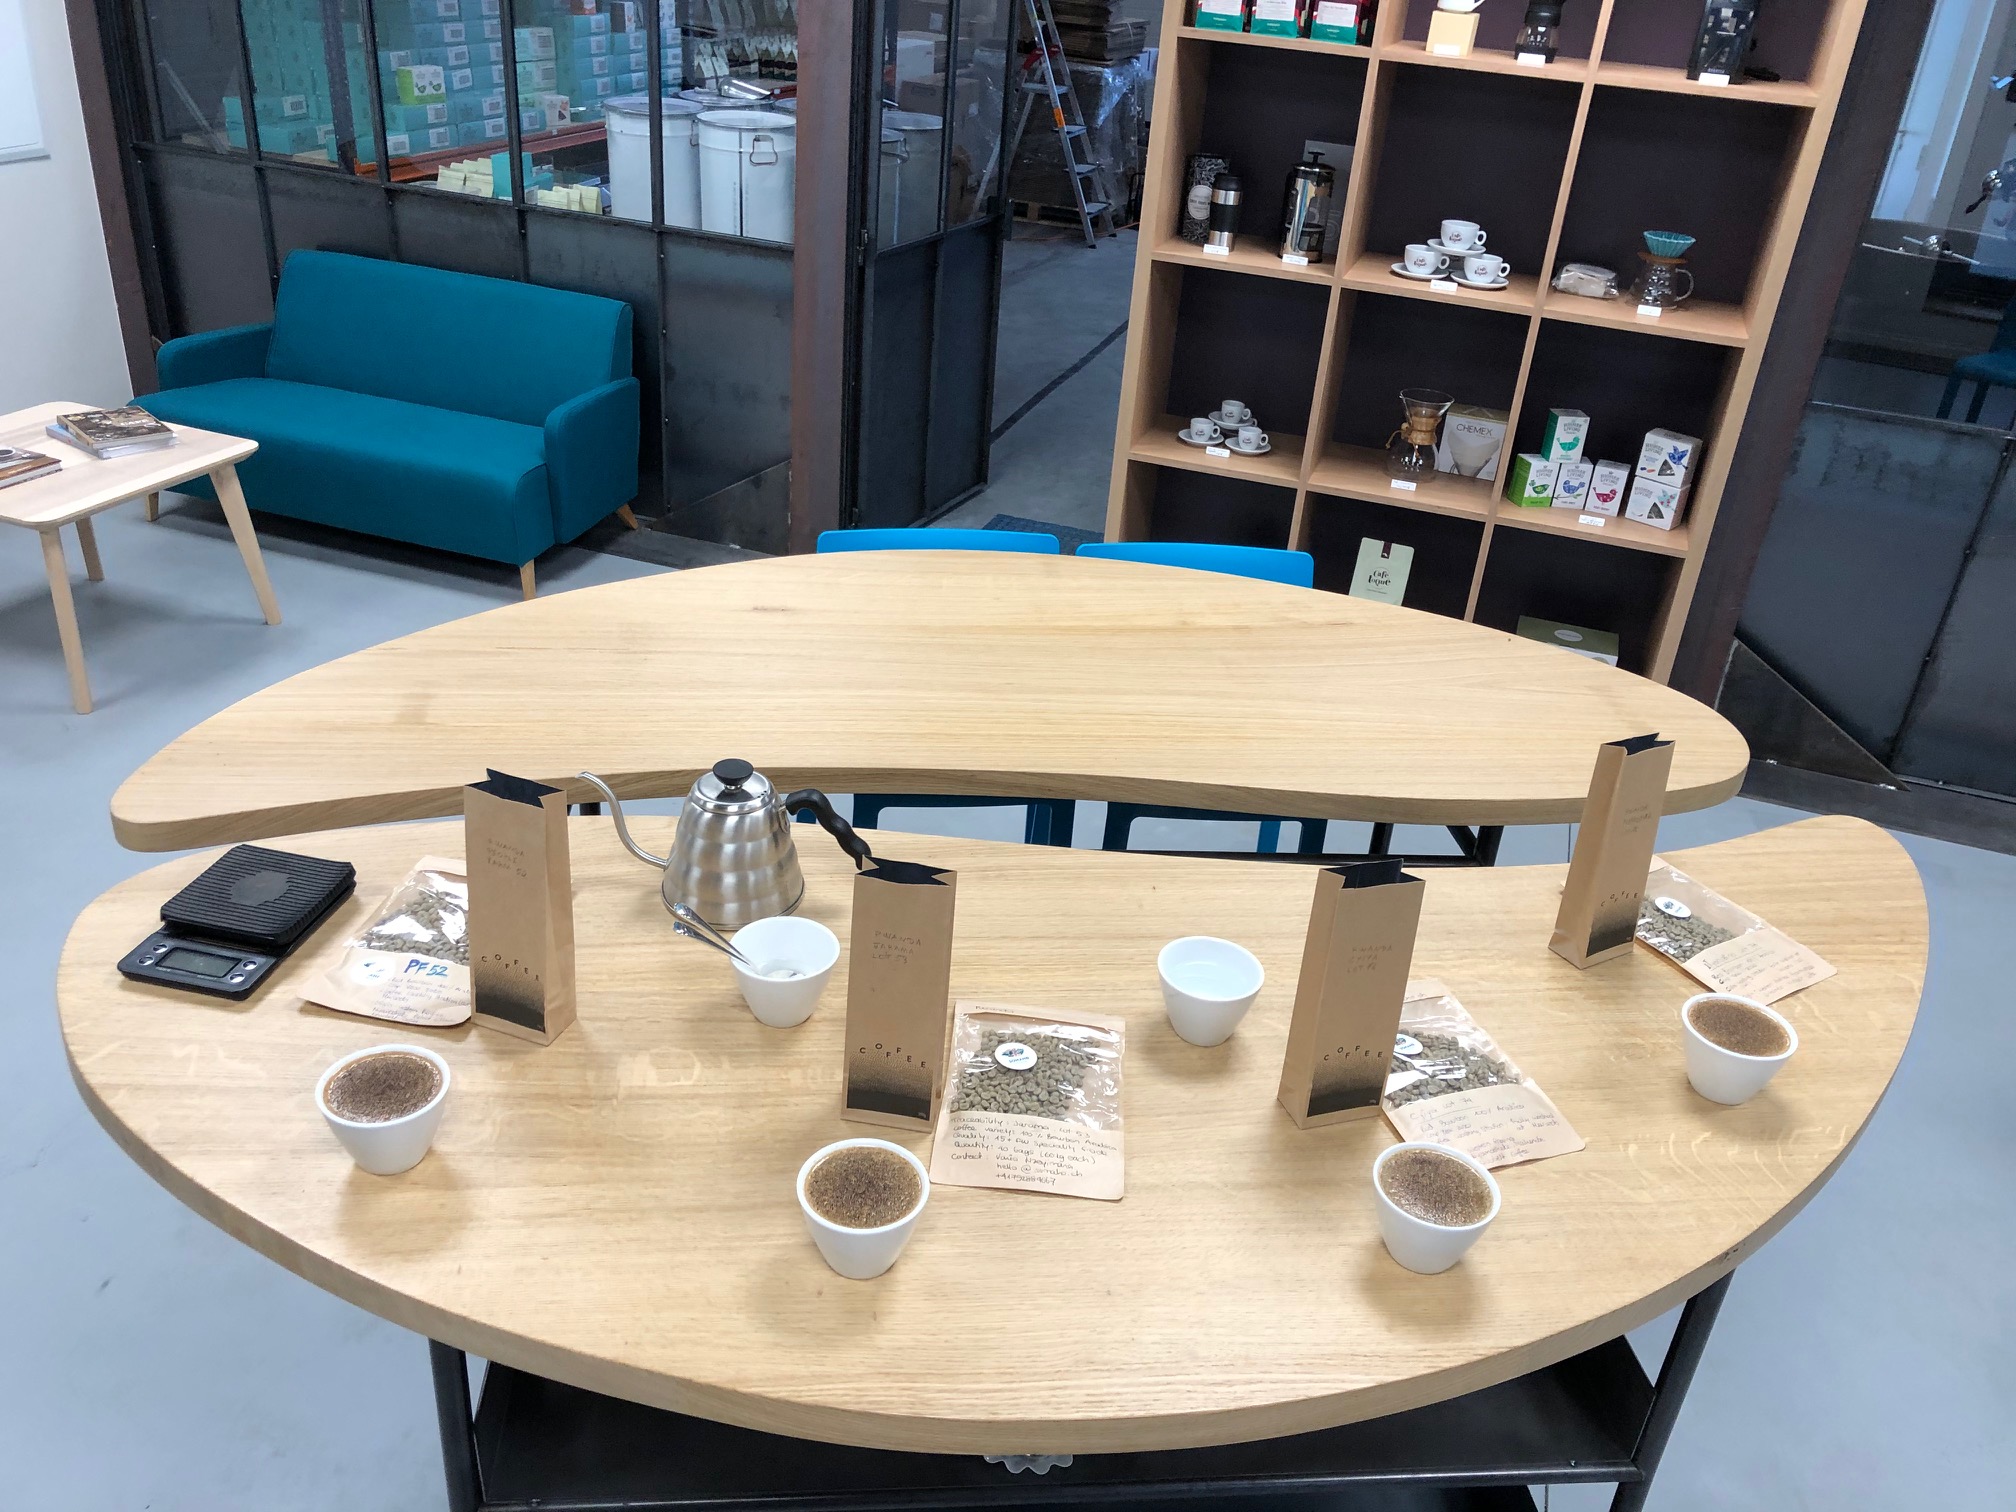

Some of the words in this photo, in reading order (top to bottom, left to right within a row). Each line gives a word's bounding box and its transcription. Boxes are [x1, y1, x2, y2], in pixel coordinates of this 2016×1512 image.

[1456, 423, 1493, 436] CHEMEX
[481, 953, 540, 982] COFFEE
[859, 1043, 926, 1069] COFFEE
[1323, 1045, 1383, 1061] COFFEE
